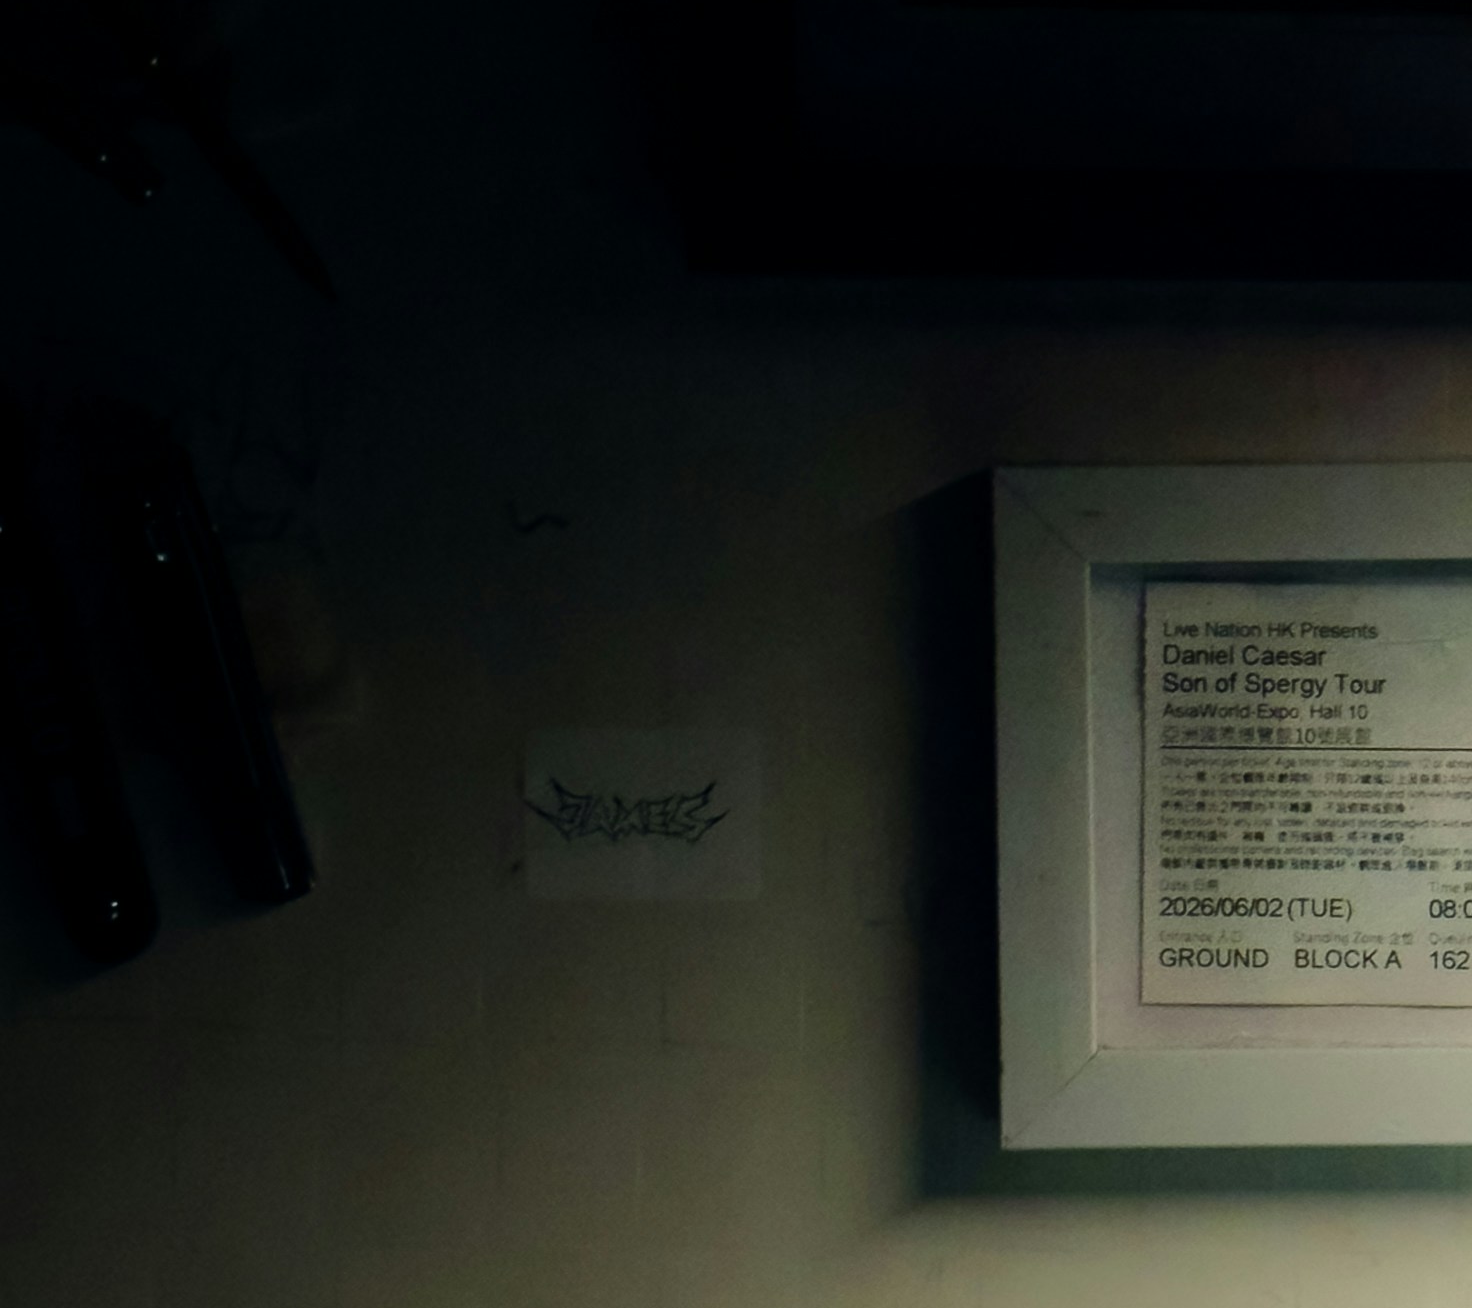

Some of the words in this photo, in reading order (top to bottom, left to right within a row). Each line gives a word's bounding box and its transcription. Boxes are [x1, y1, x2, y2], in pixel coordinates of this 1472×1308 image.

[1163, 622, 1198, 638] Live
[1205, 622, 1262, 638] Nation
[1268, 623, 1295, 637] HK
[1300, 622, 1379, 639] Presents
[1163, 644, 1234, 666] Daniel
[1242, 645, 1326, 666] Caesar
[1163, 673, 1207, 694] Son
[1215, 673, 1237, 694] of
[1244, 673, 1328, 698] Spergy
[1334, 674, 1388, 695] Tour
[1309, 704, 1344, 719] Hall
[1350, 705, 1369, 719] 10
[1159, 896, 1283, 918] 2026/06/02
[1287, 897, 1353, 922] (TUE)
[1159, 947, 1270, 968] GROUND
[1294, 948, 1378, 969] BLOCK
[1383, 950, 1402, 969] A
[1430, 950, 1471, 970] 162
